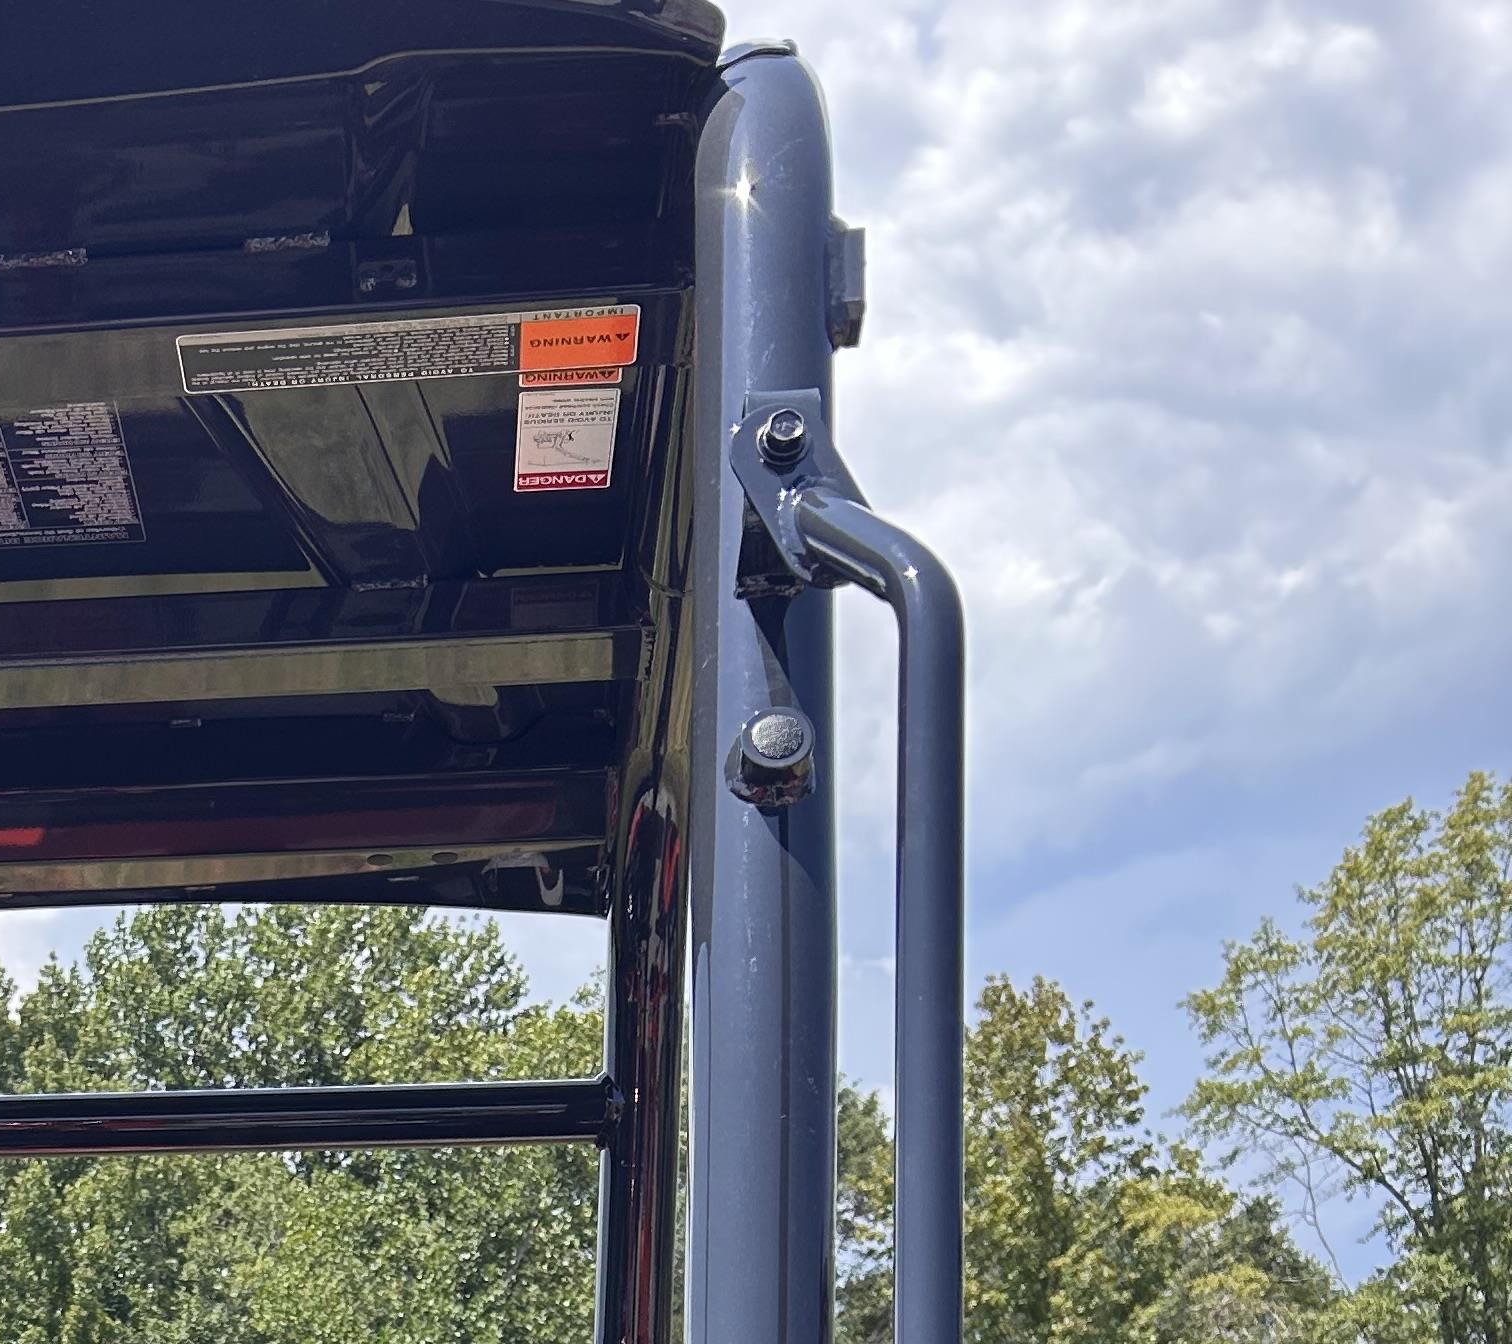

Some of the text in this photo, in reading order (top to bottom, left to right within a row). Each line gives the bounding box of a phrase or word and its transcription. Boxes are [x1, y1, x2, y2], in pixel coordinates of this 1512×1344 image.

[533, 307, 624, 320] IMPORTANT
[529, 334, 612, 348] WARNING
[525, 371, 598, 382] WARNING
[518, 474, 587, 486] DANGER
